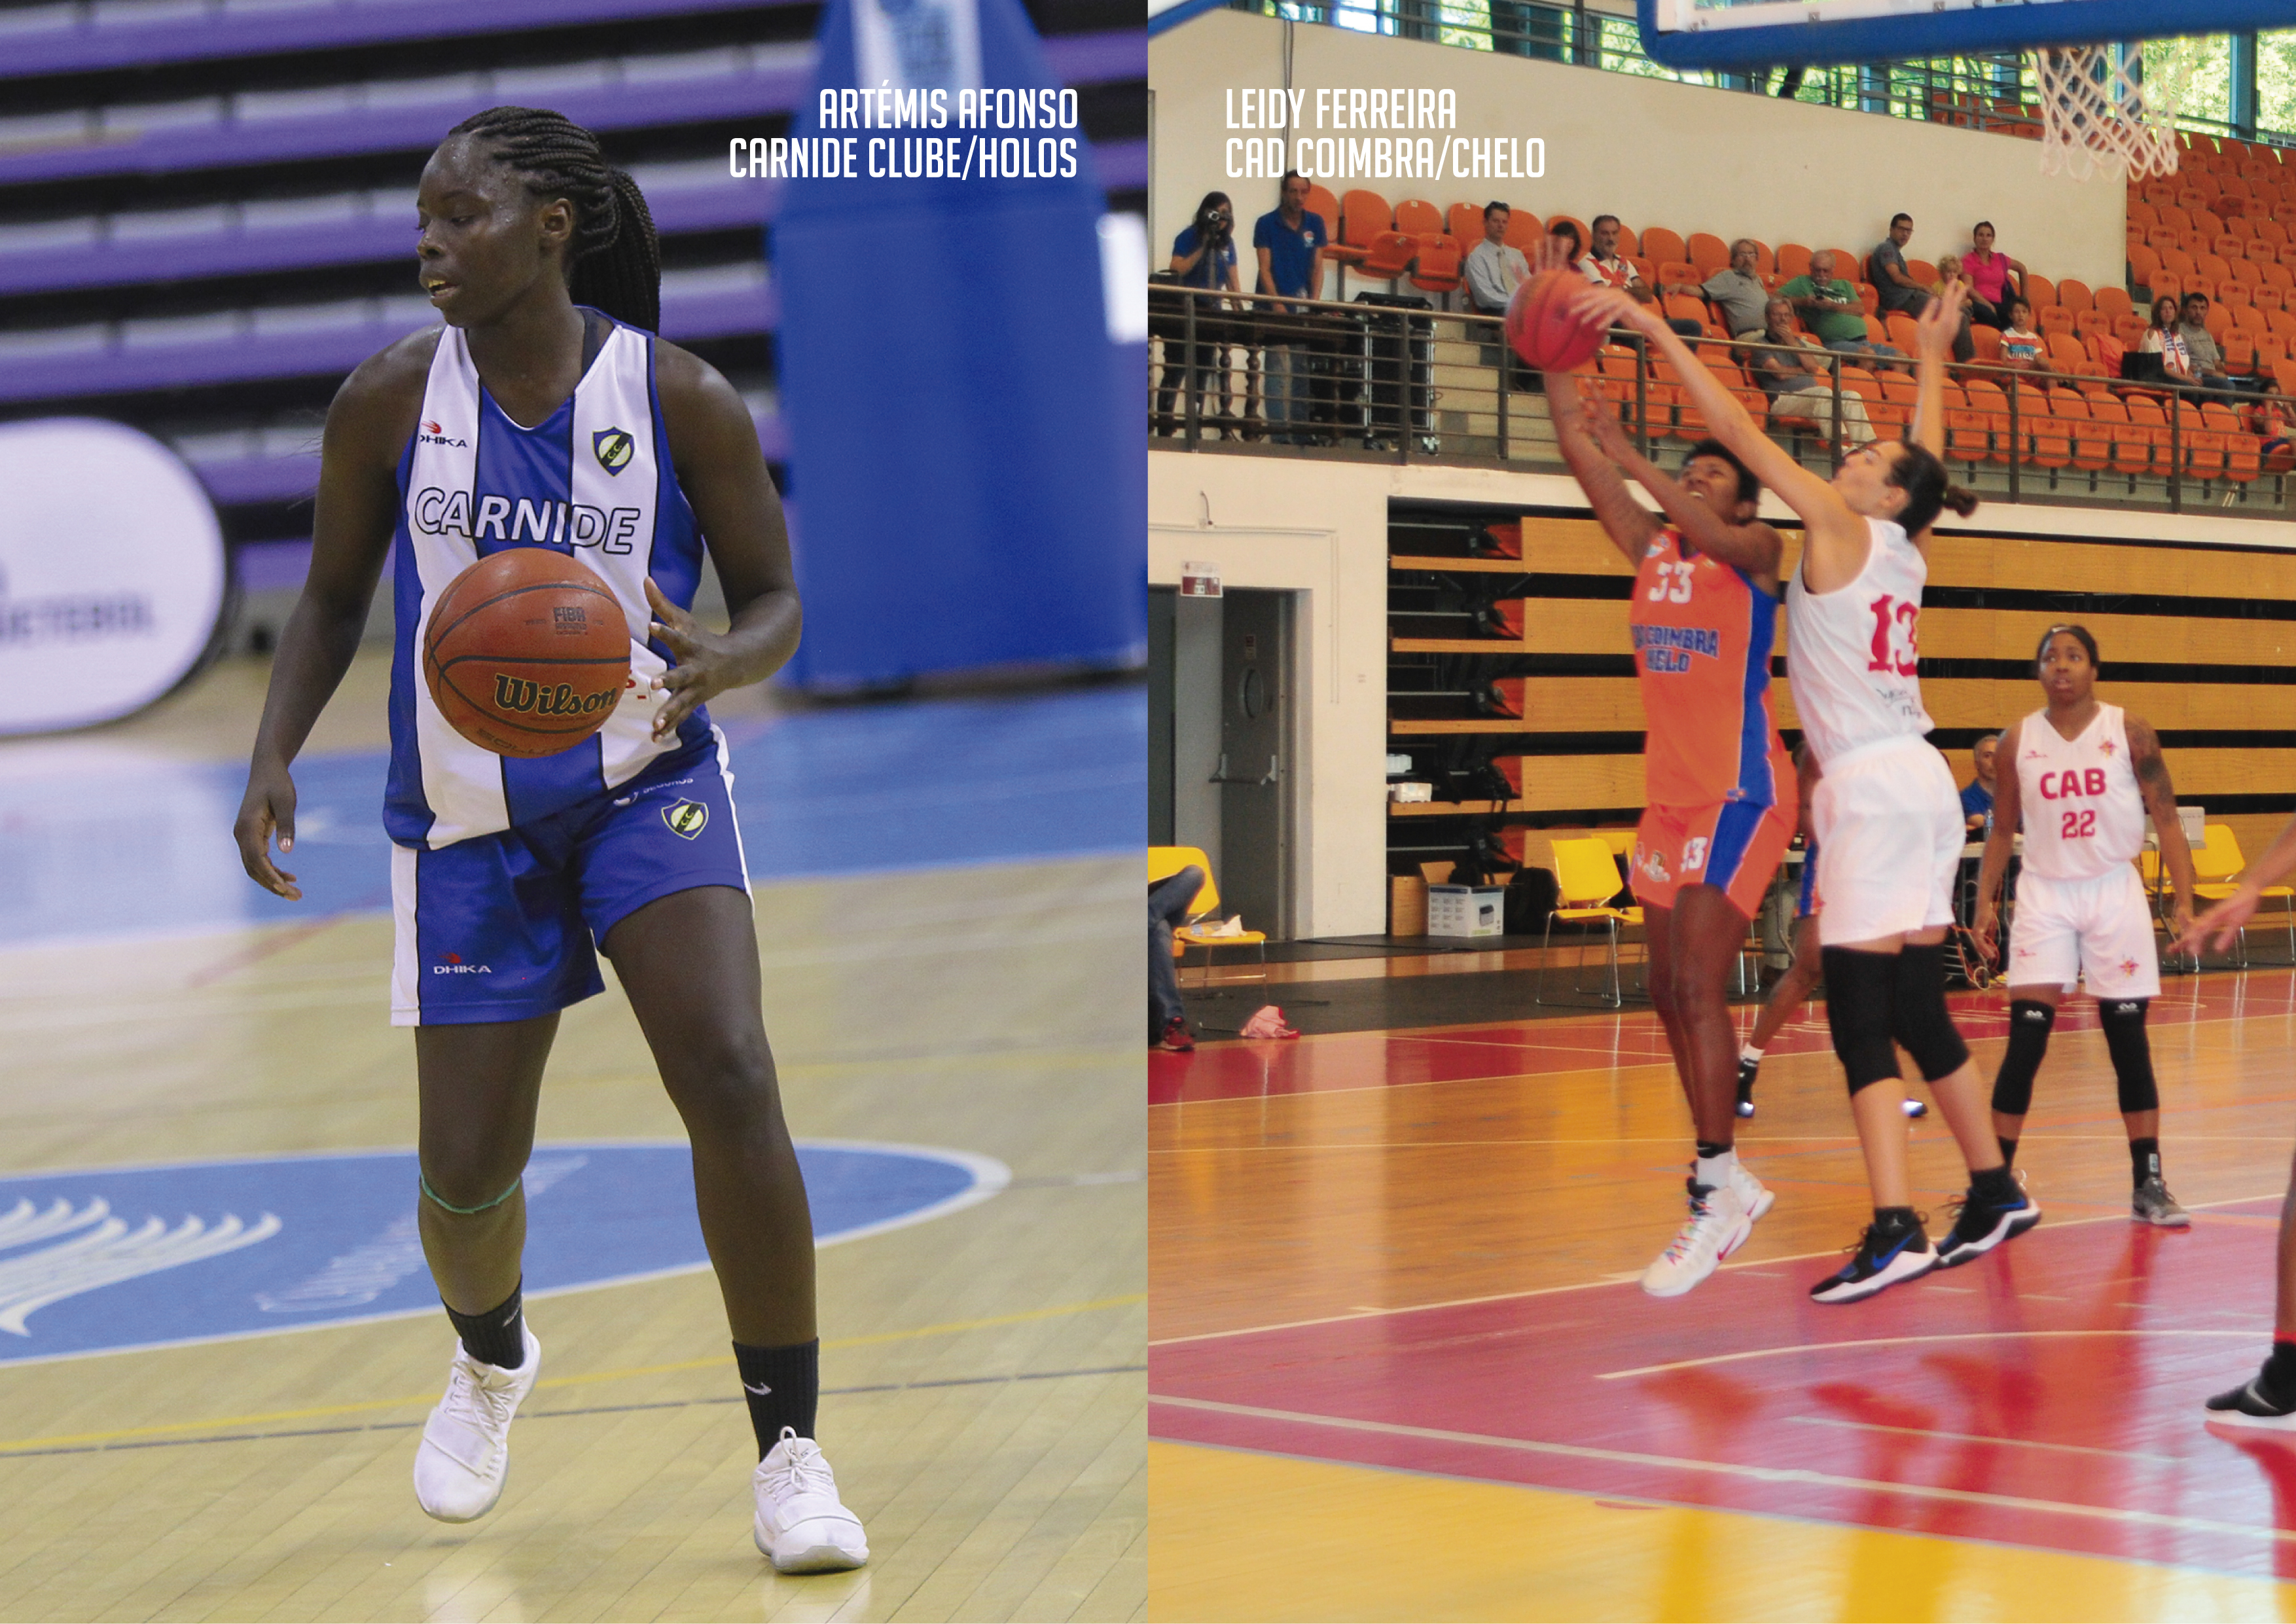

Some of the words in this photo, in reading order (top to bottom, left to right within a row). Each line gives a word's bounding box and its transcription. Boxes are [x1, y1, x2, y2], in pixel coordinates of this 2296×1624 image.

[414, 486, 641, 554] CARNIDE
[1867, 593, 1920, 677] 13
[494, 672, 618, 716] Wilson
[2039, 767, 2107, 800] CAB
[2061, 809, 2096, 840] 22
[433, 965, 492, 975] DHIKA
